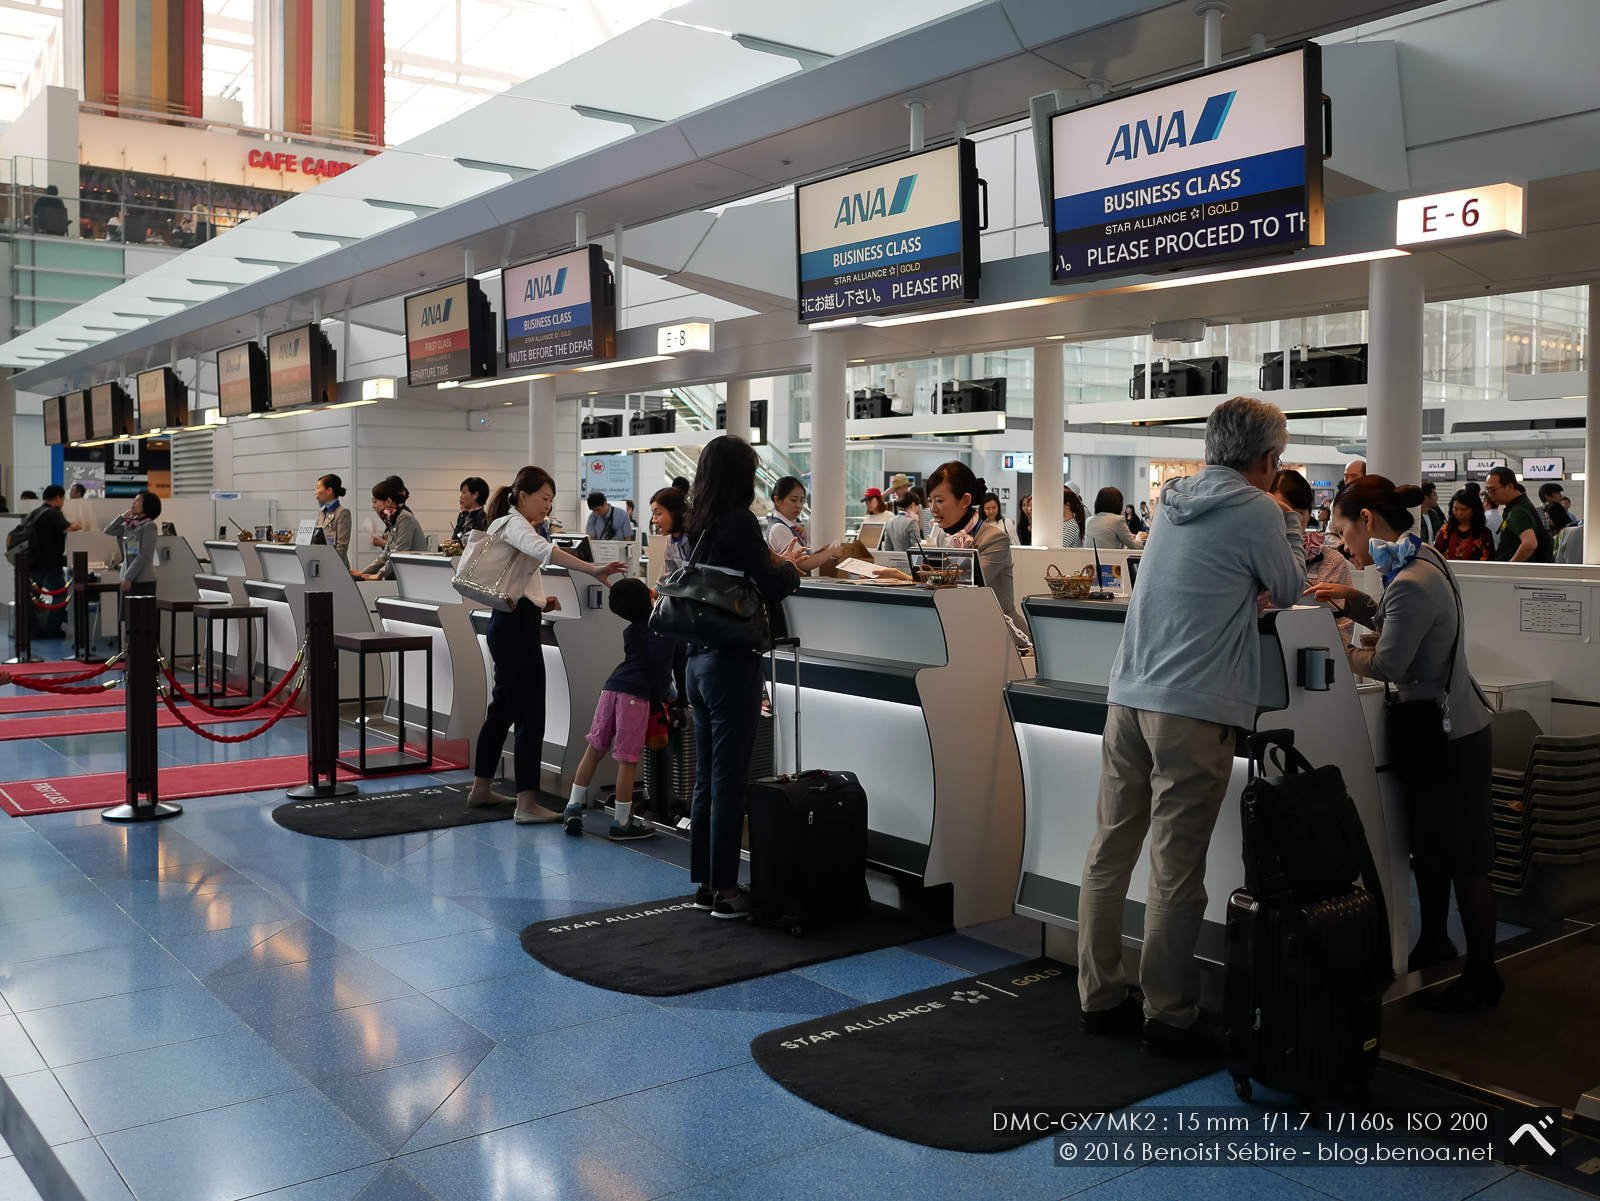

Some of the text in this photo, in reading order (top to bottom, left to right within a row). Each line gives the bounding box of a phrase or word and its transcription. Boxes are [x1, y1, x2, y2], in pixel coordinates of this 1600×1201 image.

[1105, 110, 1187, 165] ANA
[248, 149, 297, 172] CAFE
[1104, 168, 1241, 214] BUSINESS CLASS
[834, 187, 886, 228] ANA
[1105, 201, 1239, 235] STAR ALLIANCE GOLD
[1422, 198, 1480, 233] E-6
[833, 237, 921, 268] BUSINESS CLASS
[1087, 240, 1149, 267] PLEASE
[1155, 223, 1244, 255] PROCEED
[1250, 216, 1279, 239] TO
[524, 274, 553, 302] ANA
[834, 262, 920, 286] STAR ALLIANCE GOLD
[892, 273, 962, 299] PLEASE PR
[421, 303, 442, 328] ANA
[524, 312, 572, 331] BUSINESS CLASS
[437, 338, 452, 350] CLASS
[528, 346, 553, 360] BEFORE
[554, 343, 568, 356] THE
[548, 902, 694, 934] STAR ALLIANCE
[780, 969, 1062, 1050] STAR ALLIANCE GOLD
